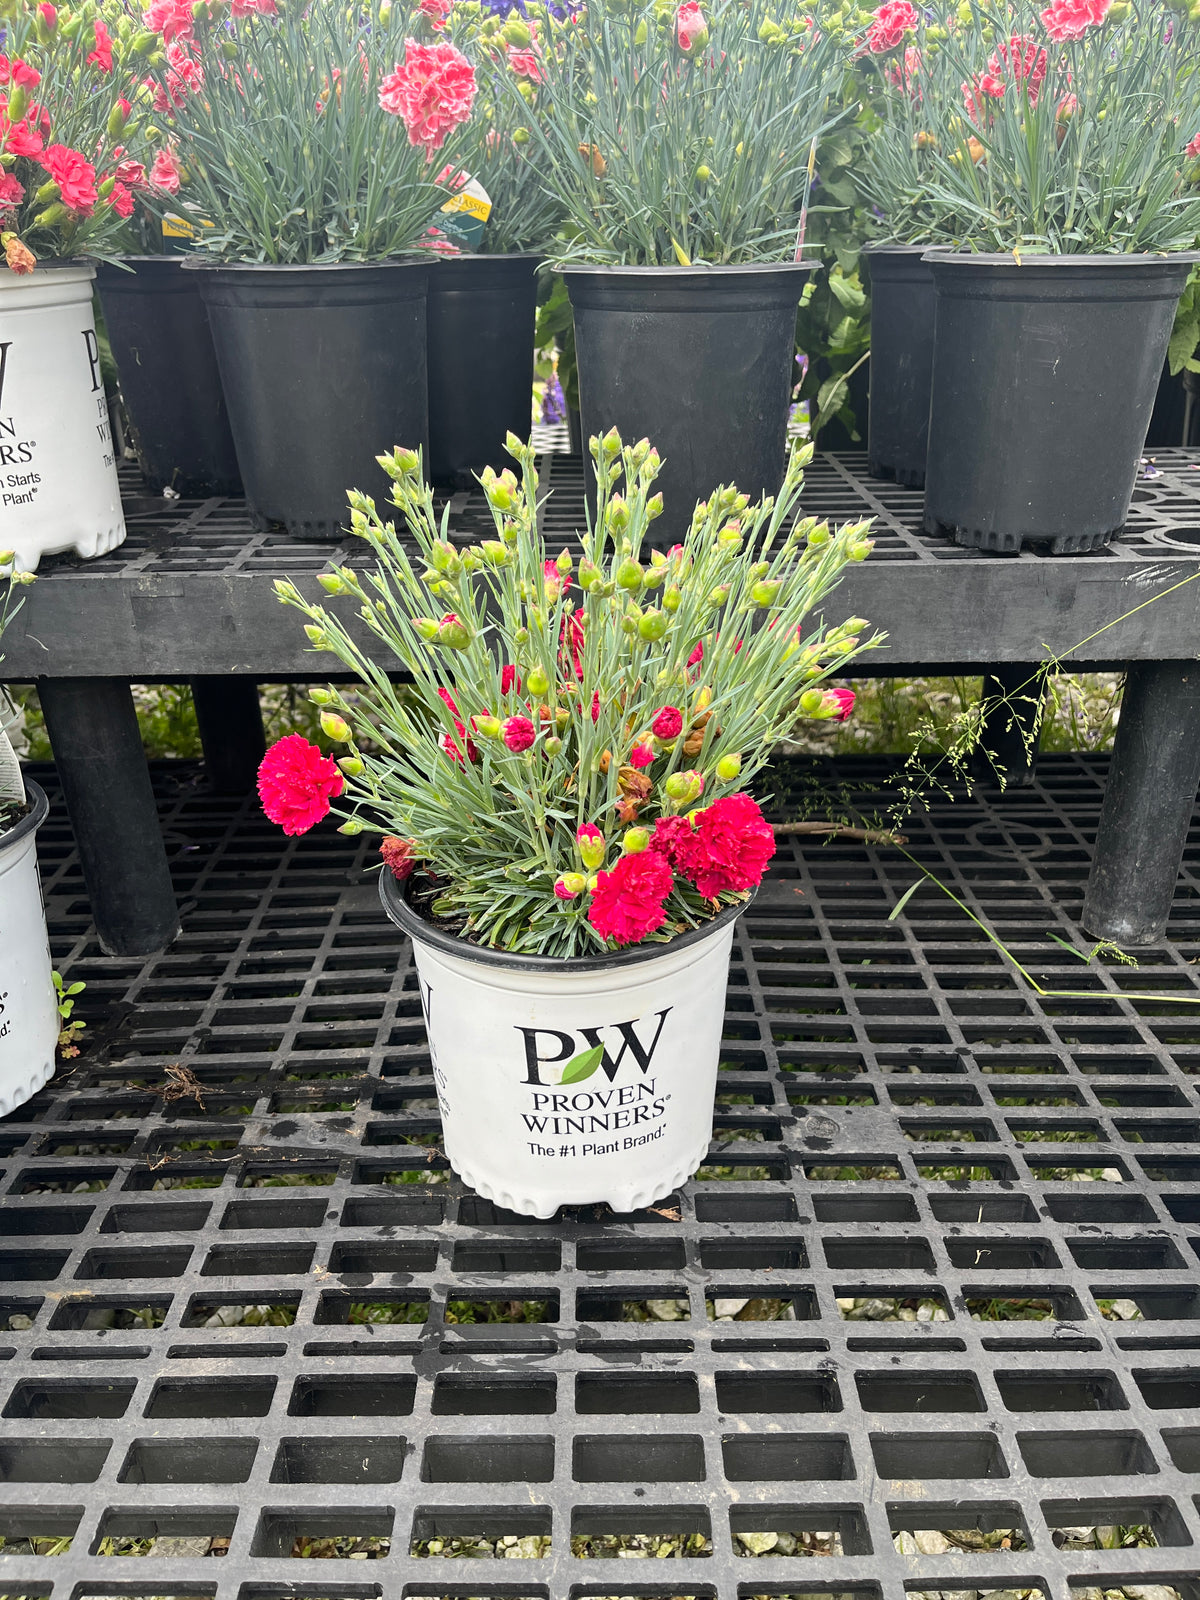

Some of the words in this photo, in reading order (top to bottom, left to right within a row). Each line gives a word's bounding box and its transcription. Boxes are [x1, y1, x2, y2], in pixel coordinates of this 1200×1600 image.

[7, 472, 41, 487] Starts
[531, 1077, 657, 1112] PROVEN
[527, 1142, 555, 1157] The
[559, 1145, 576, 1157] #1
[582, 1141, 619, 1157] Plant
